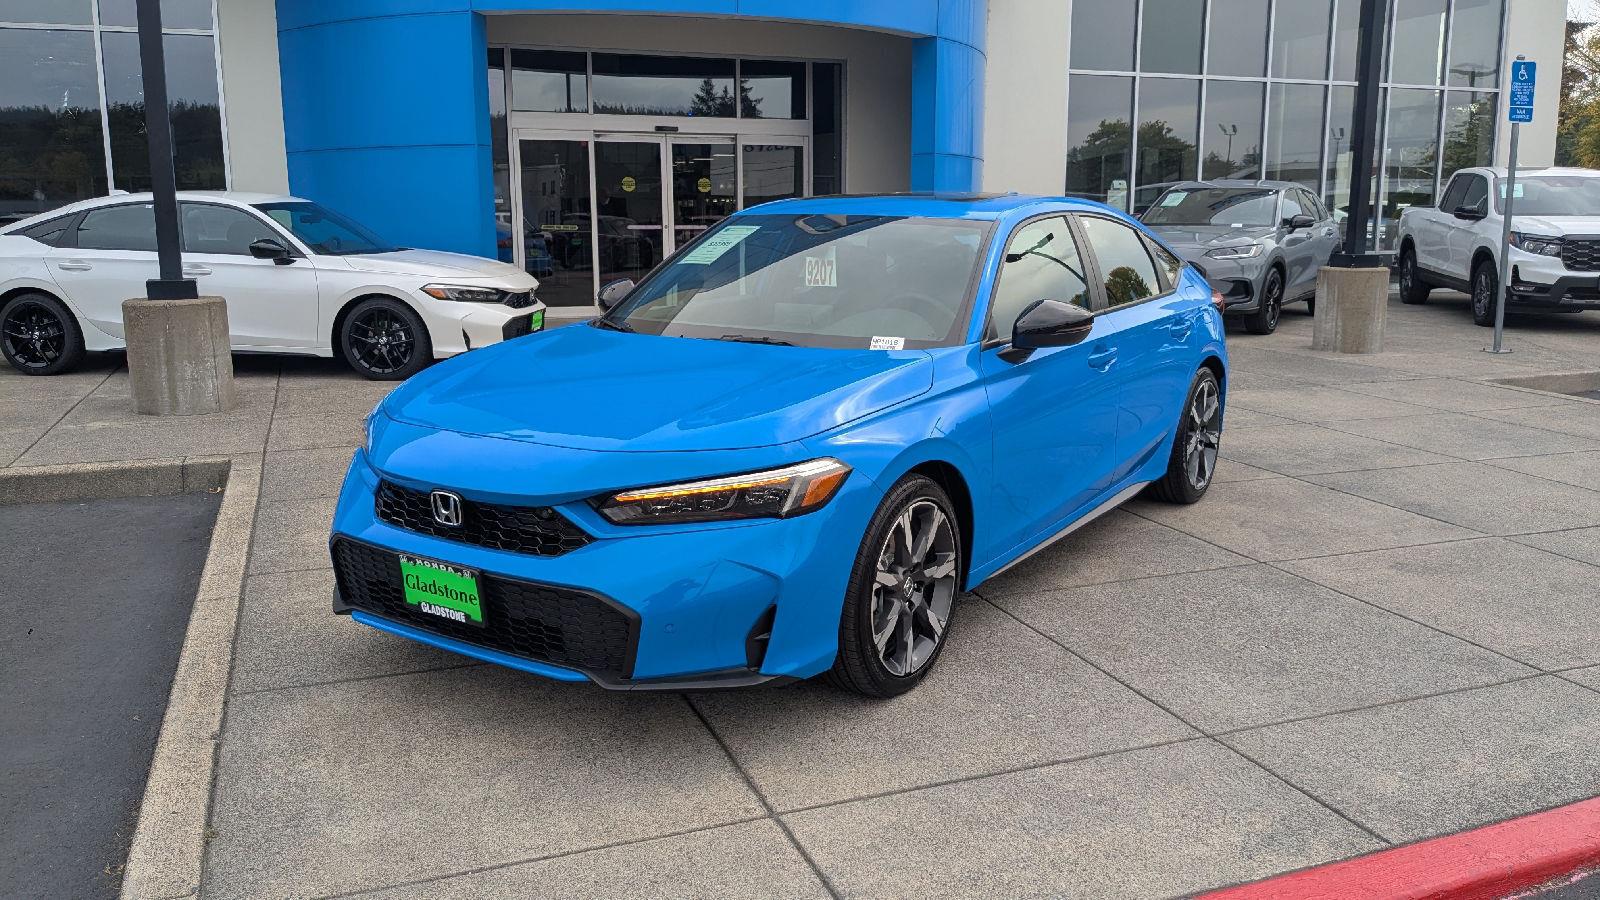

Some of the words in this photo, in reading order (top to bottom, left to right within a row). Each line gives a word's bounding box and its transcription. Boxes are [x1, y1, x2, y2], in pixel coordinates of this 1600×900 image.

[807, 260, 834, 286] 9207
[415, 559, 455, 573] HONDA
[405, 573, 478, 606] Gladstone
[421, 602, 466, 623] GLADSTONE
